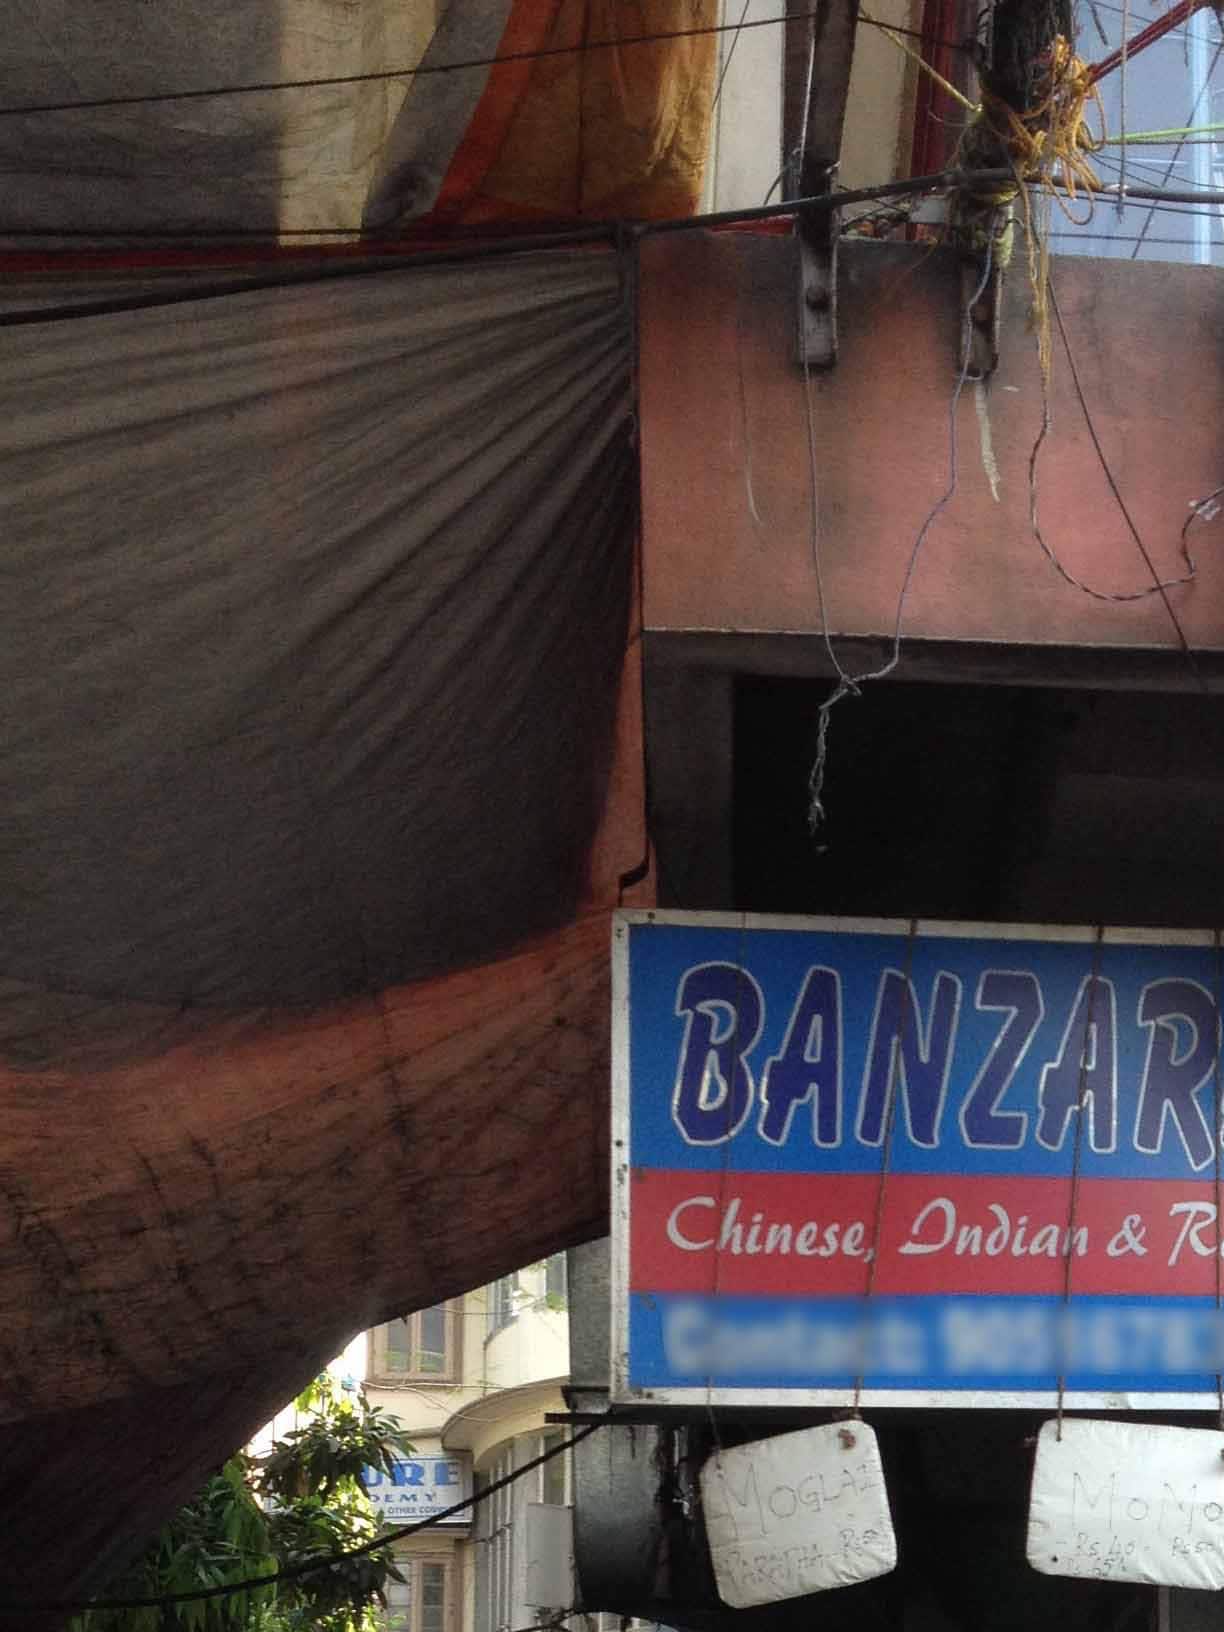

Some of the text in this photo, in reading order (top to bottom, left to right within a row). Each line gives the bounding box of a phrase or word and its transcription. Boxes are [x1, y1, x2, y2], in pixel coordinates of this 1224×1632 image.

[666, 1196, 876, 1264] Chinese,
[899, 1197, 1089, 1258] Indian
[1107, 1214, 1149, 1258] &
